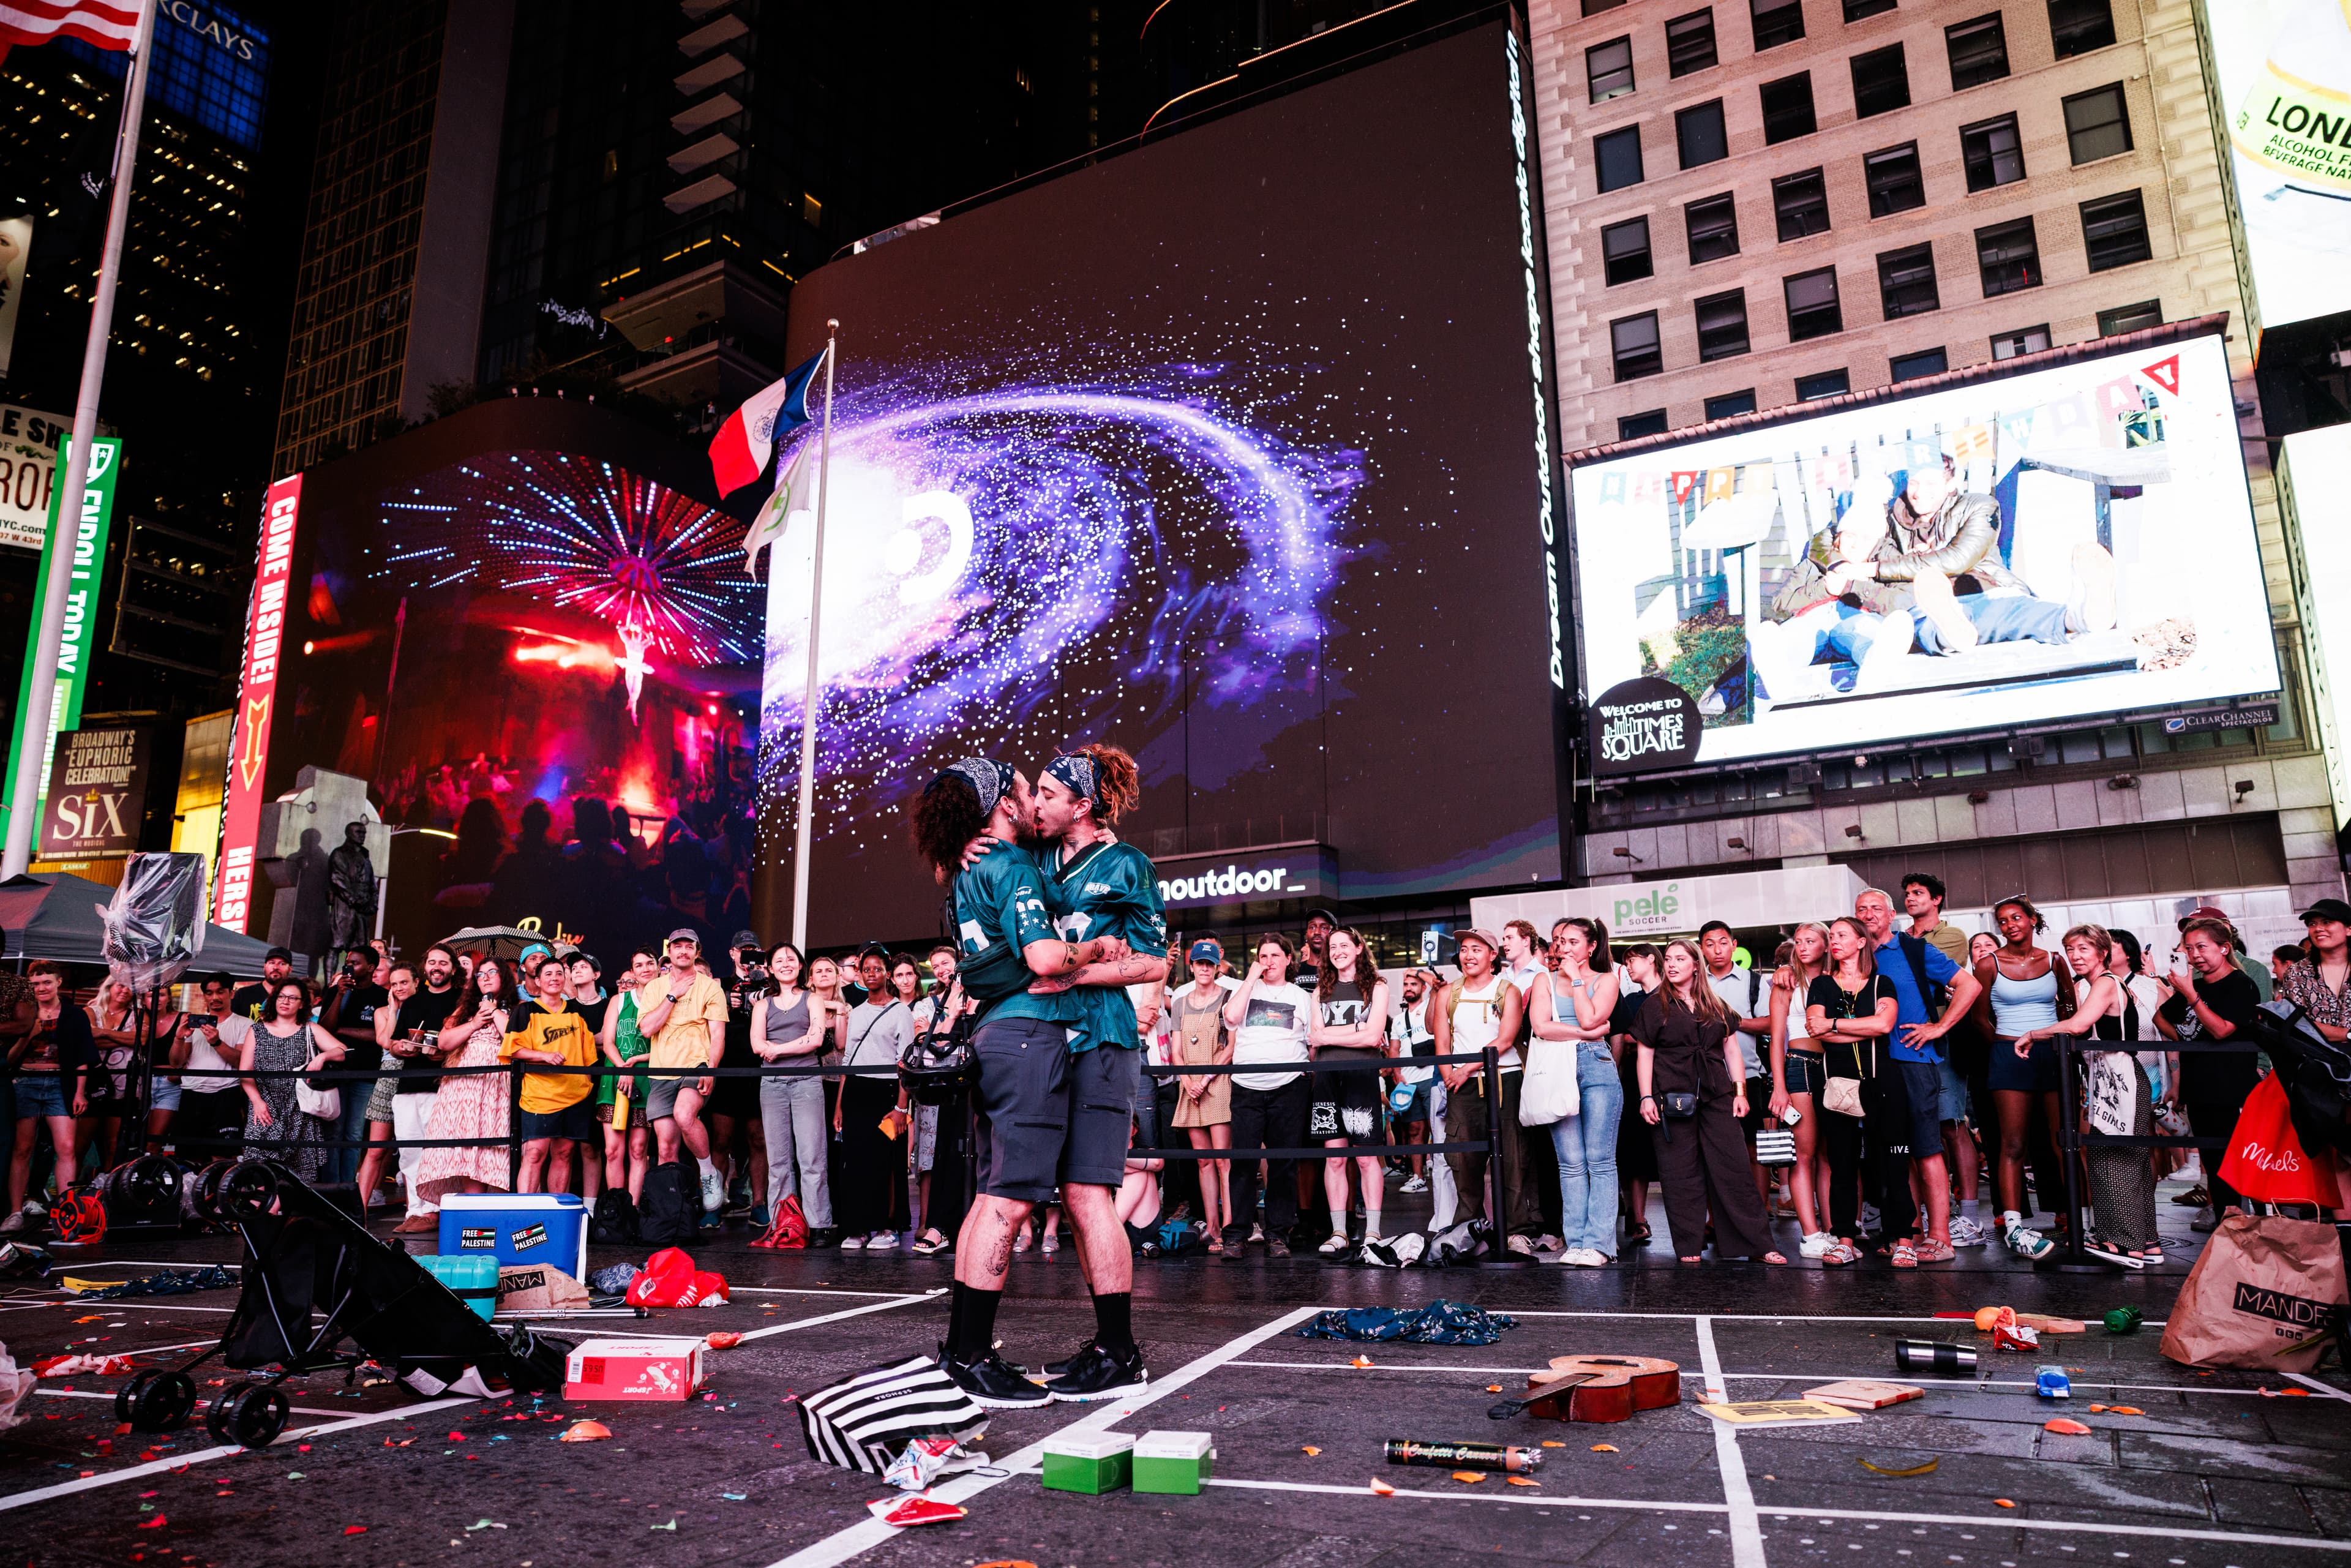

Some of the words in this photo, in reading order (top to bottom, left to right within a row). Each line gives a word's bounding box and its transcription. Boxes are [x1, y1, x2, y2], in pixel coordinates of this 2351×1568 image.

[1507, 49, 1526, 162] digital
[2263, 145, 2324, 173] BEVERAGE
[2270, 134, 2334, 163] ALCOHOL
[1516, 162, 1534, 268] iconic
[1524, 268, 1543, 383] shape
[1533, 382, 1554, 544] Outdoor
[263, 496, 296, 577] COME
[1545, 552, 1564, 689] Dream
[250, 579, 286, 685] INSIDE!
[1599, 702, 1664, 718] WELCOME
[1664, 698, 1682, 709] TO
[1636, 713, 1684, 734] TIMES
[2221, 717, 2273, 727] SPECTACOLOR
[72, 730, 135, 748] BROADWAY'S
[1602, 728, 1685, 762] SQUARE
[1614, 883, 1678, 926] pelé
[1629, 916, 1667, 926] SOCCER
[462, 1239, 495, 1248] PALESTINE
[512, 1231, 528, 1242] FREE
[515, 1233, 547, 1251] PALESTINE
[583, 1364, 593, 1373] 6.5
[593, 1365, 604, 1374] US
[874, 1389, 912, 1400] SEPHORA
[1408, 1444, 1453, 1460] Confetti
[1456, 1447, 1498, 1461] Cannon
